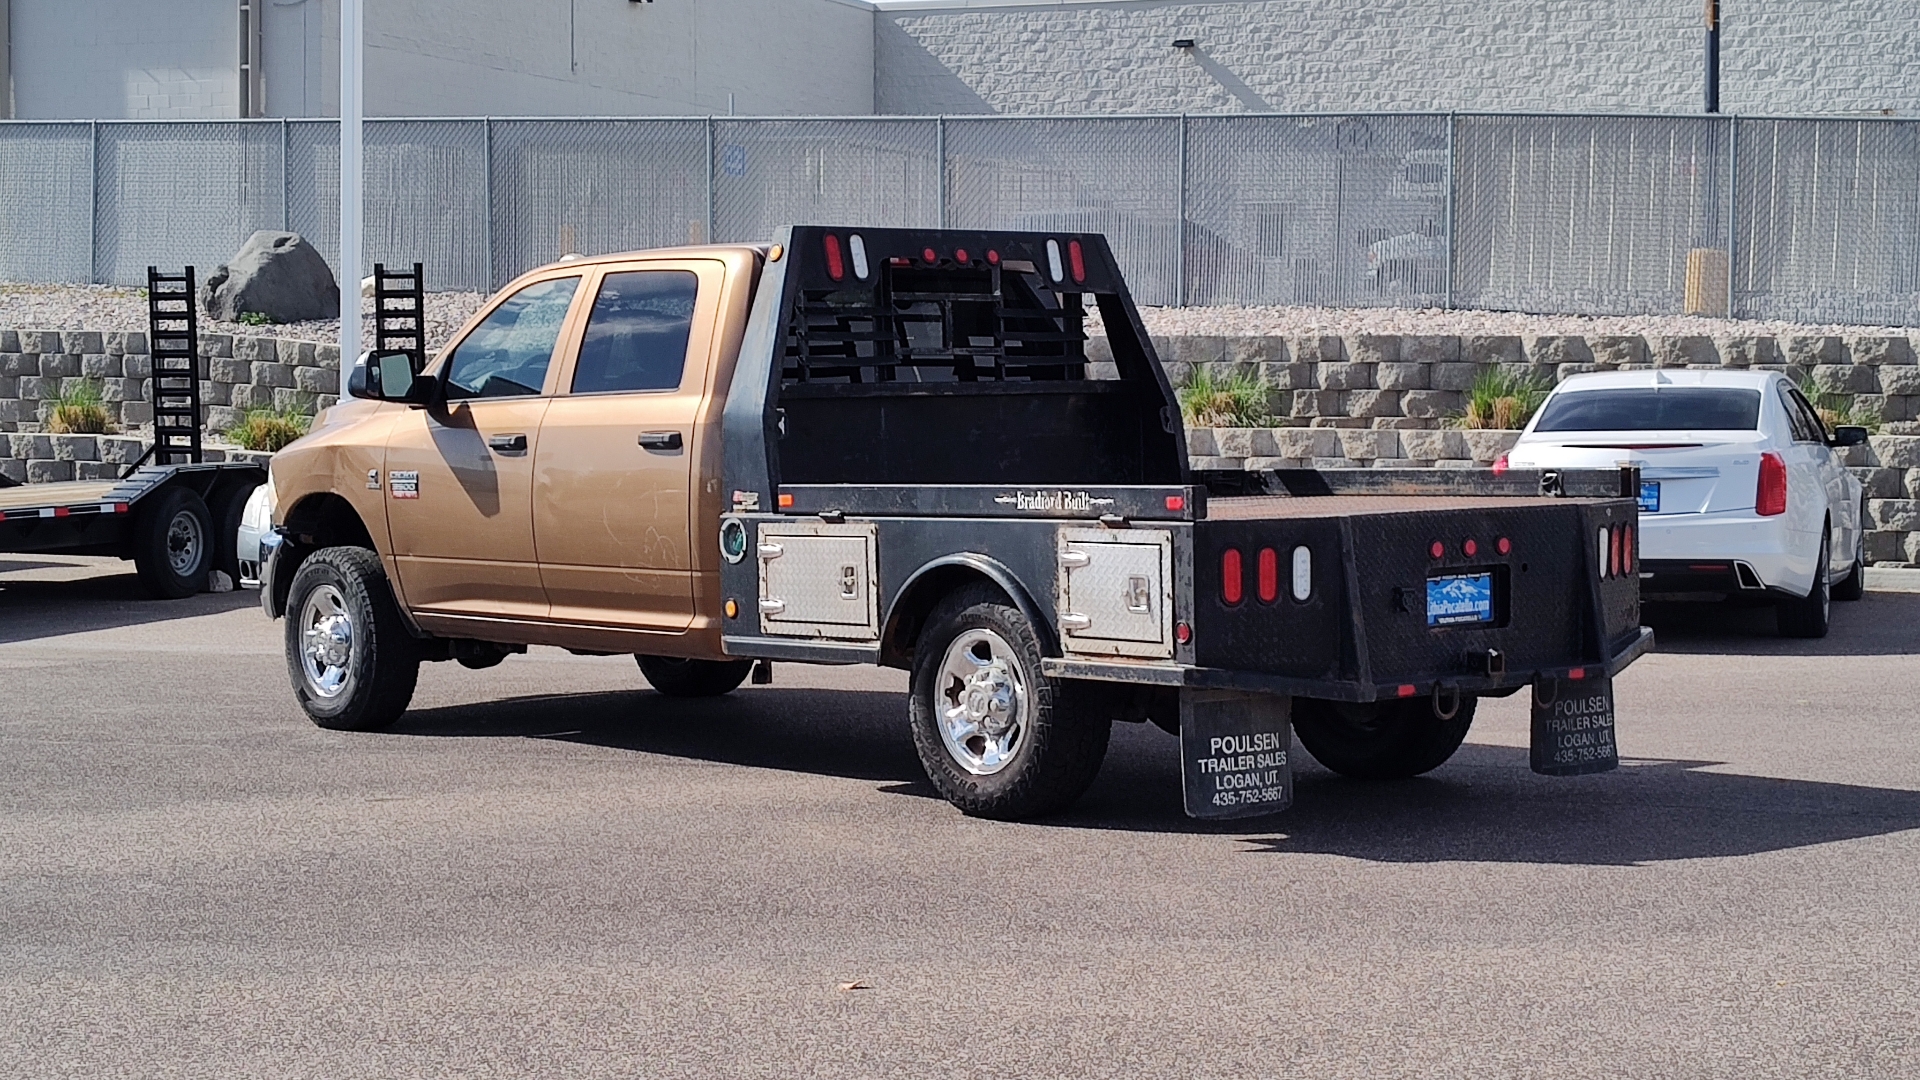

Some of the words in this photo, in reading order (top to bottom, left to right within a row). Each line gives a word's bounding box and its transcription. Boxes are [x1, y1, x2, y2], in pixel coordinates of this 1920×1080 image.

[1063, 491, 1091, 510] Built
[1555, 695, 1610, 716] POULSEN
[1545, 716, 1591, 733] TRAILER
[1210, 732, 1280, 756] POULSEN
[1197, 755, 1255, 774] TRAILER
[1257, 750, 1287, 769] SALES
[1215, 772, 1263, 790] LOGAN,
[1211, 785, 1283, 807] 435-752-5667
